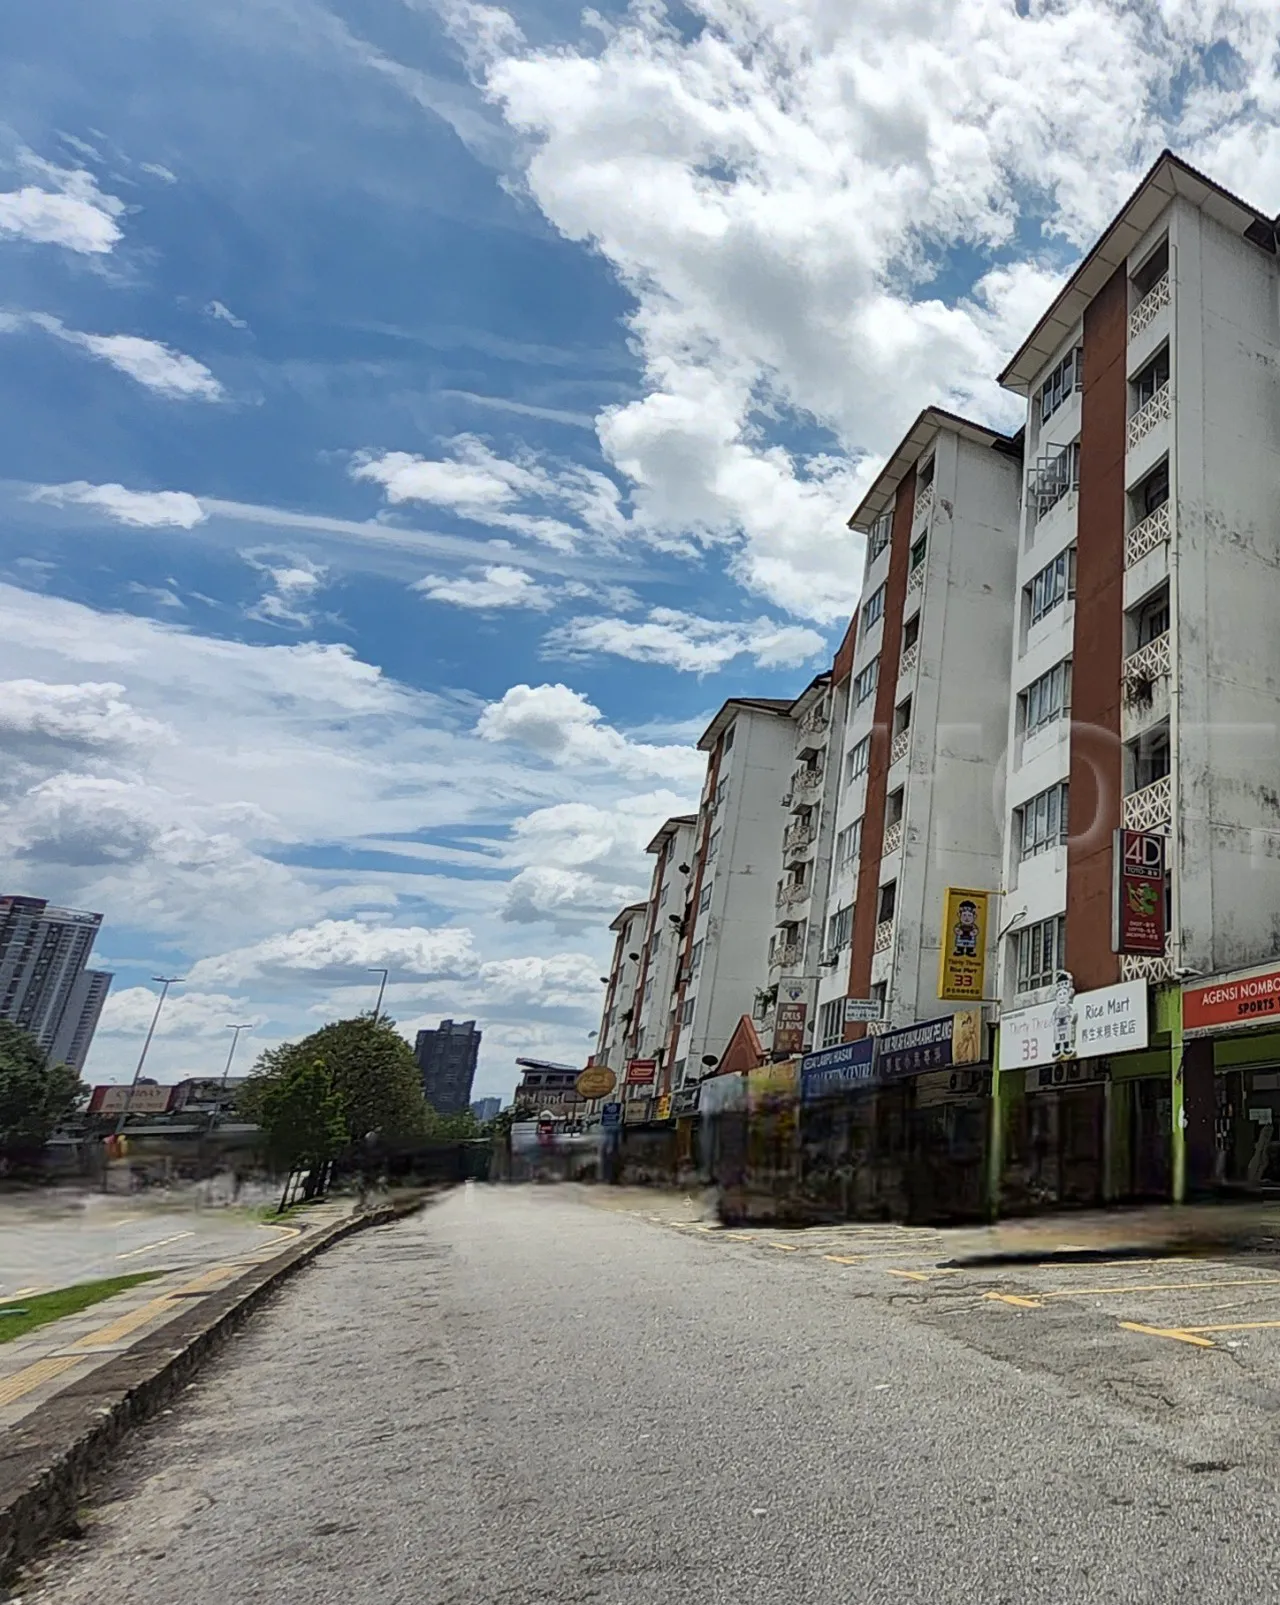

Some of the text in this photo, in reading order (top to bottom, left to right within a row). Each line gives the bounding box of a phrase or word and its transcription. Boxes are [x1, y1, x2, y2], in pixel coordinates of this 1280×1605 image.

[1125, 836, 1161, 865] 4D
[954, 974, 973, 987] 33
[1201, 986, 1238, 1006] AGENSI
[1237, 997, 1275, 1016] SPORTS
[1085, 996, 1131, 1020] Rice Mart
[1021, 1037, 1039, 1061] 33
